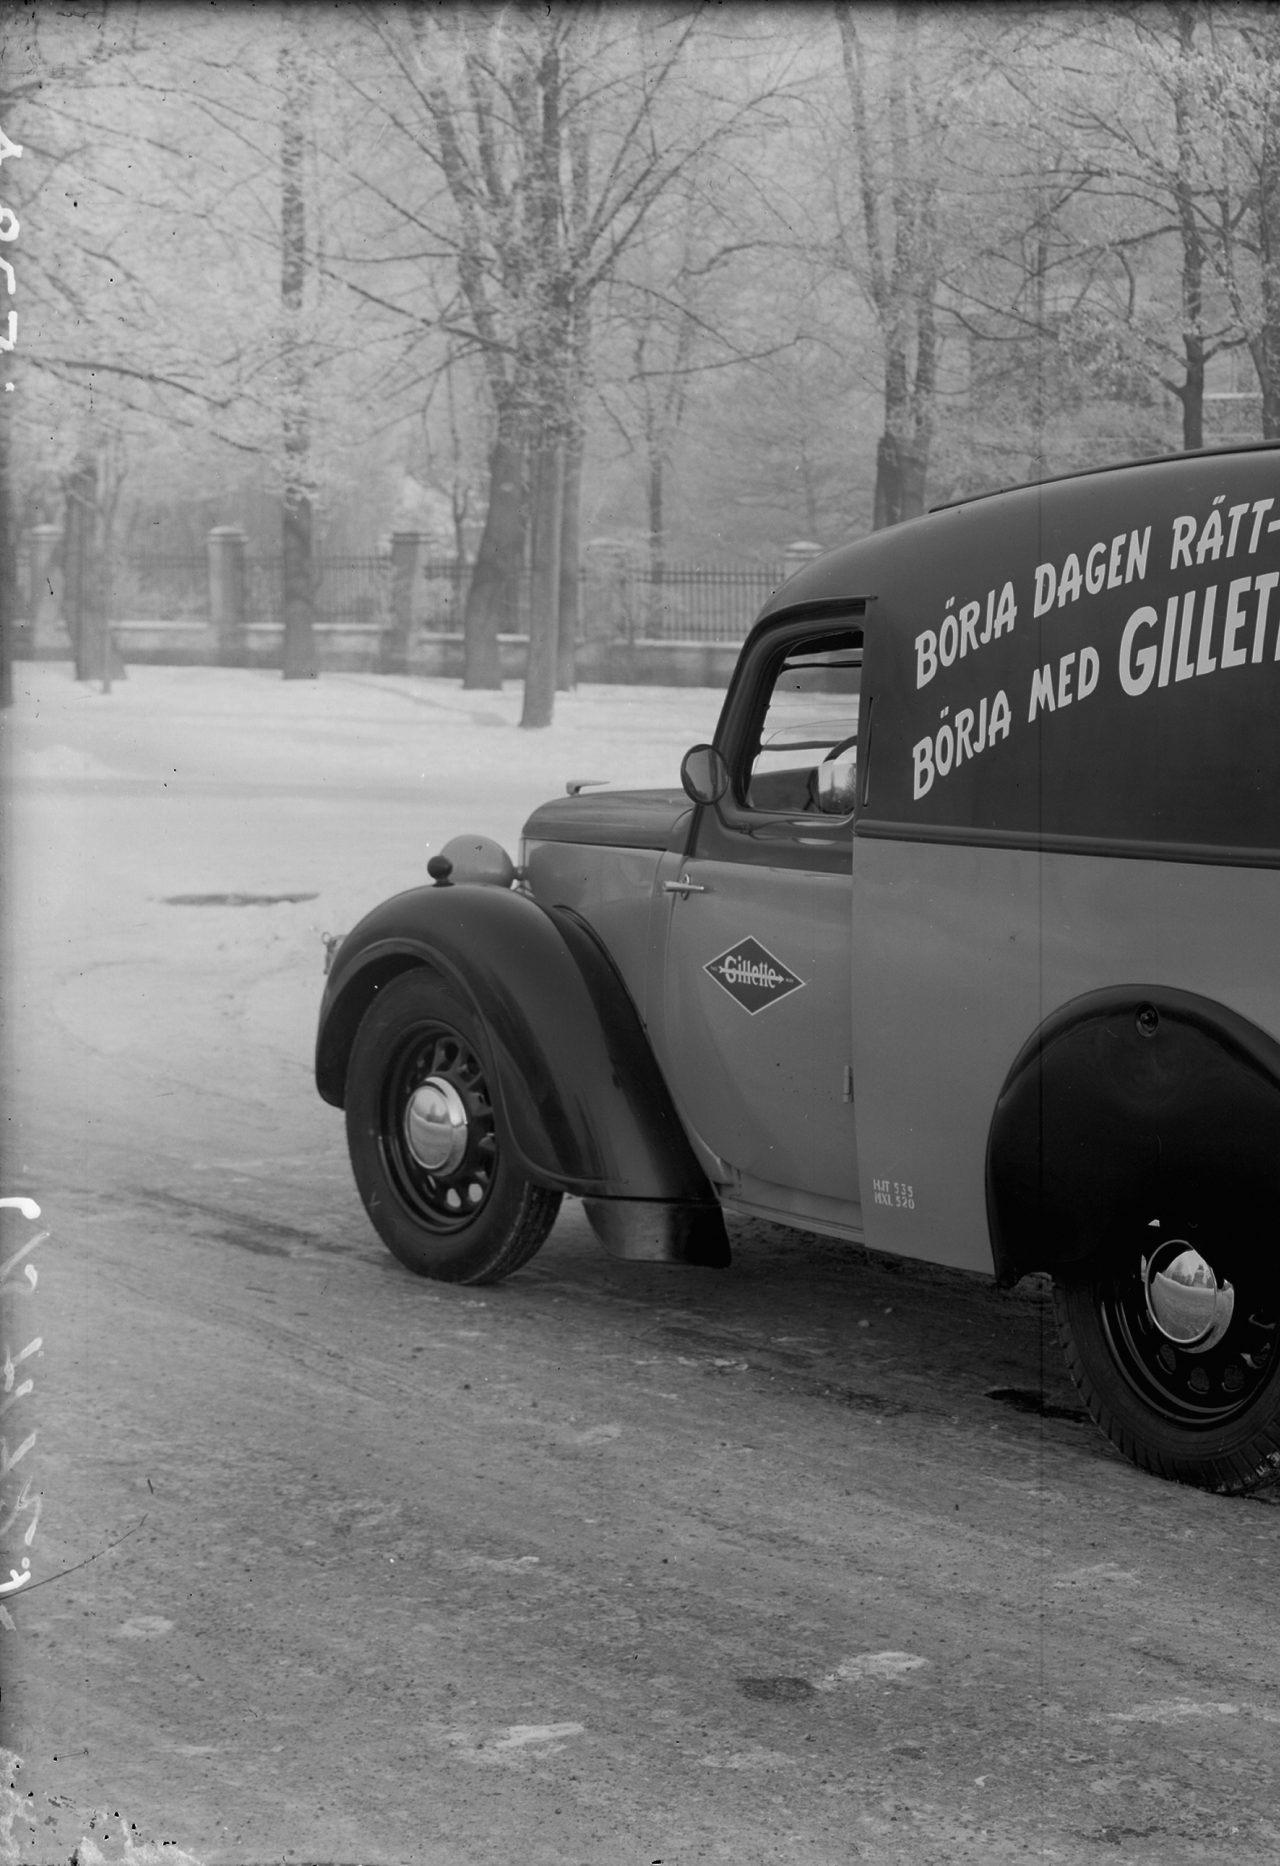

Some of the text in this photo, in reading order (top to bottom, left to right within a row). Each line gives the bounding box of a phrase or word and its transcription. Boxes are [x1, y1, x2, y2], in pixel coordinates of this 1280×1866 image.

[914, 581, 1017, 690] BÖRJA
[1033, 526, 1152, 619] DAGEN
[912, 690, 1012, 801] BÖRJA
[1027, 646, 1101, 723] MED
[724, 955, 776, 989] Gillette
